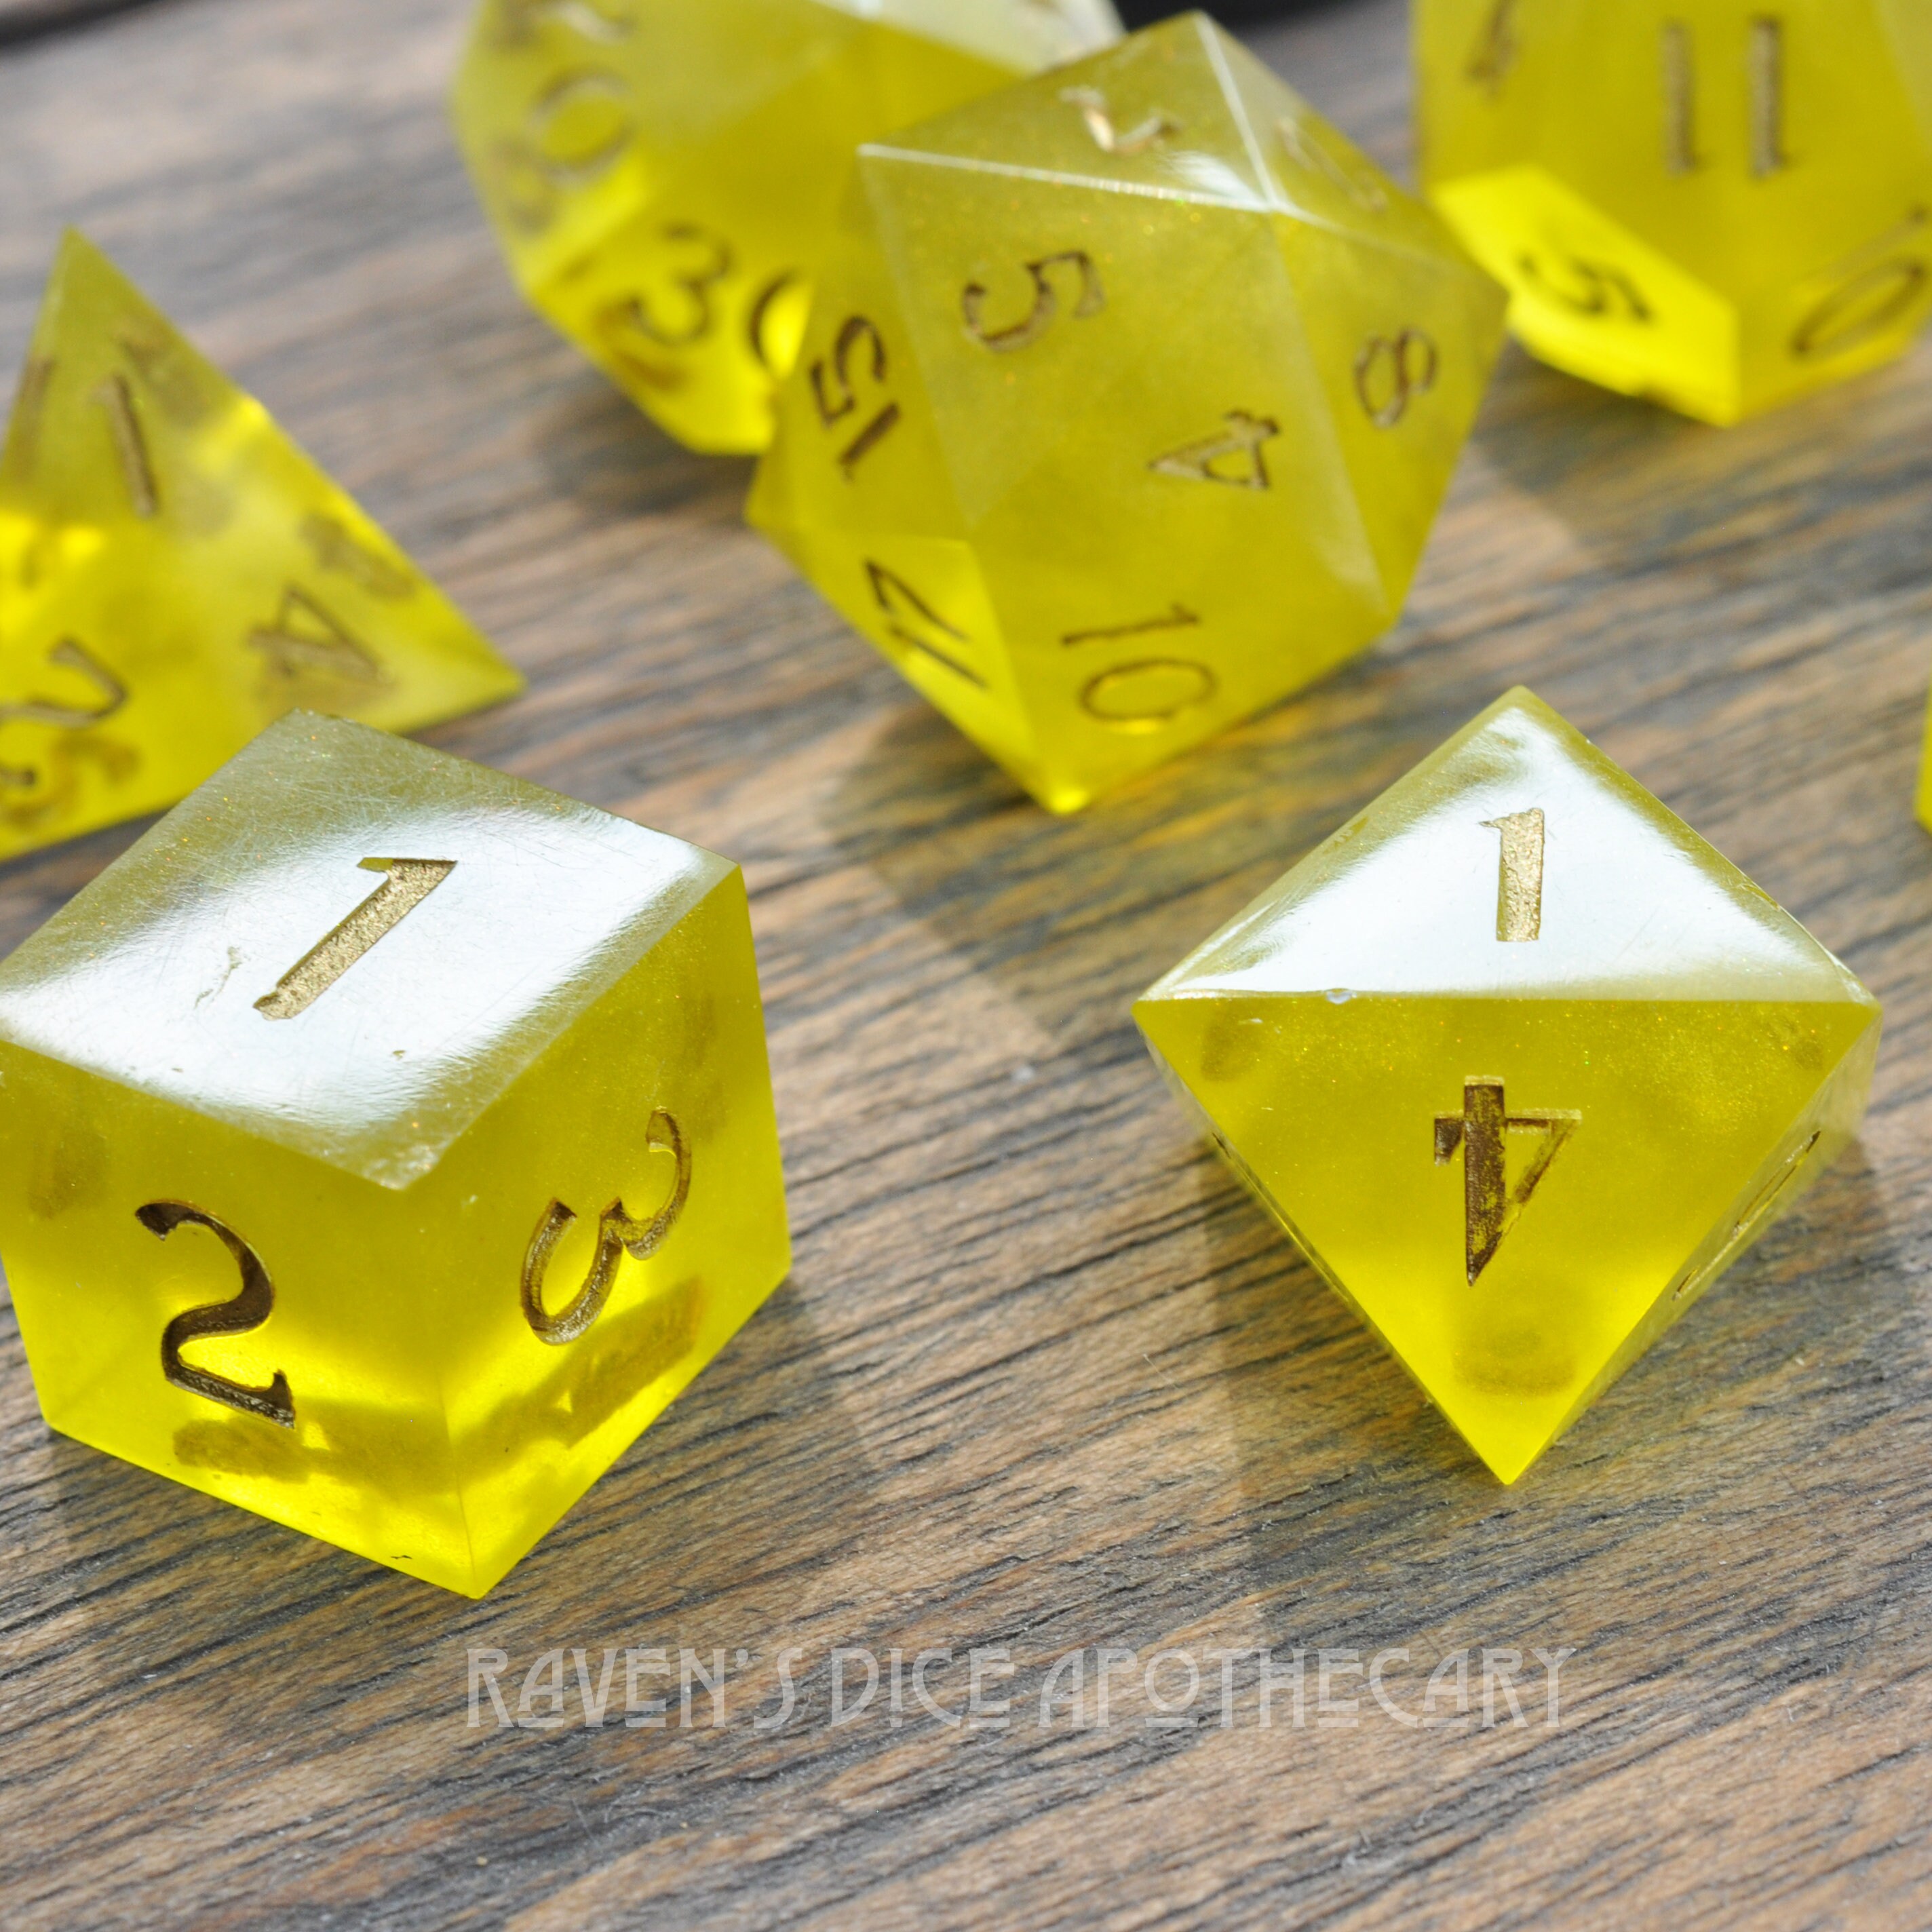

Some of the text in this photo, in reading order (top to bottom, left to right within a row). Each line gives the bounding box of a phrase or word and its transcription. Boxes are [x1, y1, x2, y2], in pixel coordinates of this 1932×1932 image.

[1657, 15, 1792, 182] 11
[960, 250, 1107, 353] 5
[1351, 326, 1440, 431] 8
[809, 314, 901, 482] 15
[1146, 408, 1281, 490] 4
[1060, 600, 1214, 724] 10
[254, 857, 457, 1019] 1
[1479, 807, 1544, 942] 1
[521, 1107, 691, 1345] 3
[1435, 1076, 1581, 1287] 4
[136, 1198, 296, 1429] 2
